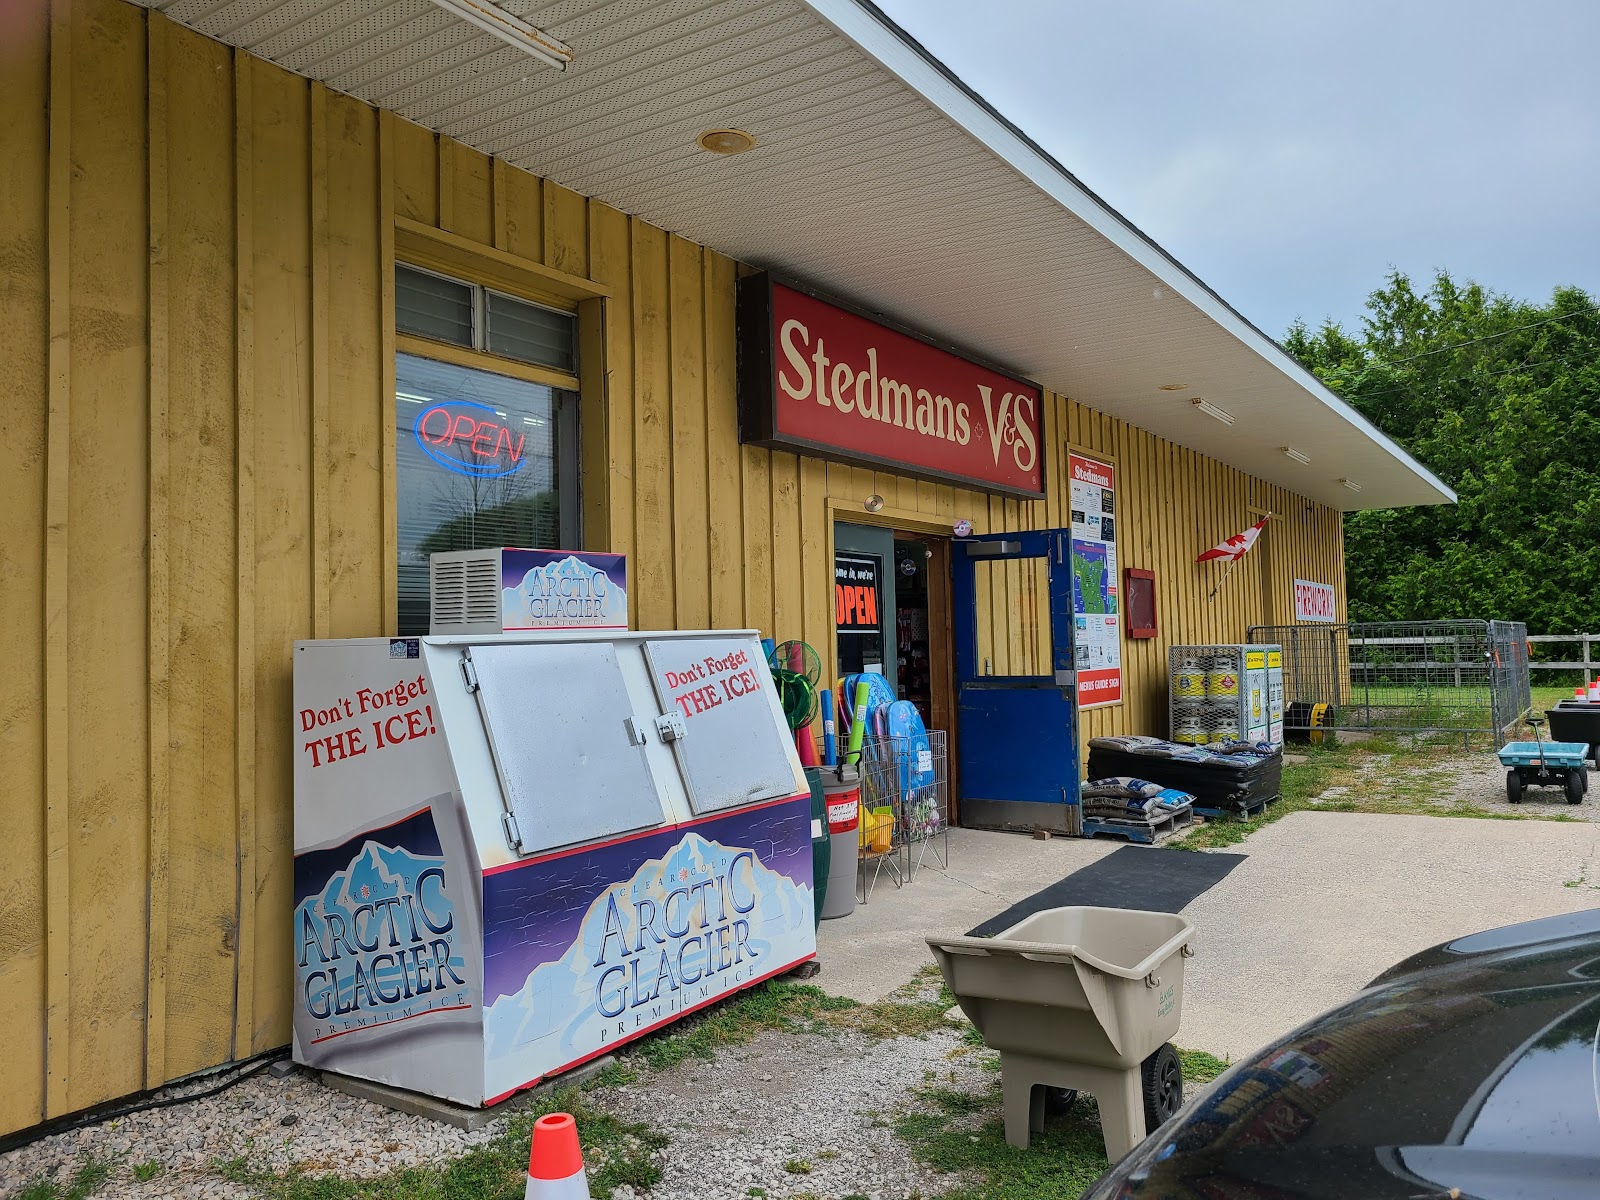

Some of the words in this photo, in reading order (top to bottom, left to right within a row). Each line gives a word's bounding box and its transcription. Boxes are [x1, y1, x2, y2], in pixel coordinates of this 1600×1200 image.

[779, 319, 970, 446] Stedmans
[977, 384, 1037, 472] V&S
[421, 408, 525, 462] OPEN
[1074, 464, 1109, 487] Stedmans
[528, 569, 606, 598] ARCTIC
[835, 568, 847, 578] ome
[857, 569, 874, 580] we're
[530, 598, 606, 619] GLACIER
[835, 584, 878, 625] OPEN
[1296, 584, 1333, 618] FIREWORKS
[664, 663, 706, 689] Don't
[703, 648, 748, 676] Forget
[1094, 679, 1108, 690] GUIDE
[300, 698, 354, 732] Don't
[356, 674, 428, 714] Forget
[675, 683, 722, 718] THE
[720, 668, 761, 701] ICE!
[304, 727, 368, 769] THE
[372, 705, 437, 751] ICE!
[312, 891, 359, 913] CLEAR
[373, 876, 411, 894] COLD
[619, 873, 676, 897] CLEAR
[690, 857, 728, 876] COLD
[298, 867, 454, 968] ARCTIC
[593, 851, 756, 968] ARCTIC
[304, 938, 466, 1020] GLACIER
[594, 918, 759, 1019] GLACIER
[315, 1007, 413, 1039] PREMIUM
[428, 993, 465, 1009] ICE
[600, 985, 709, 1043] PREMIUM
[723, 964, 755, 988] ICE
